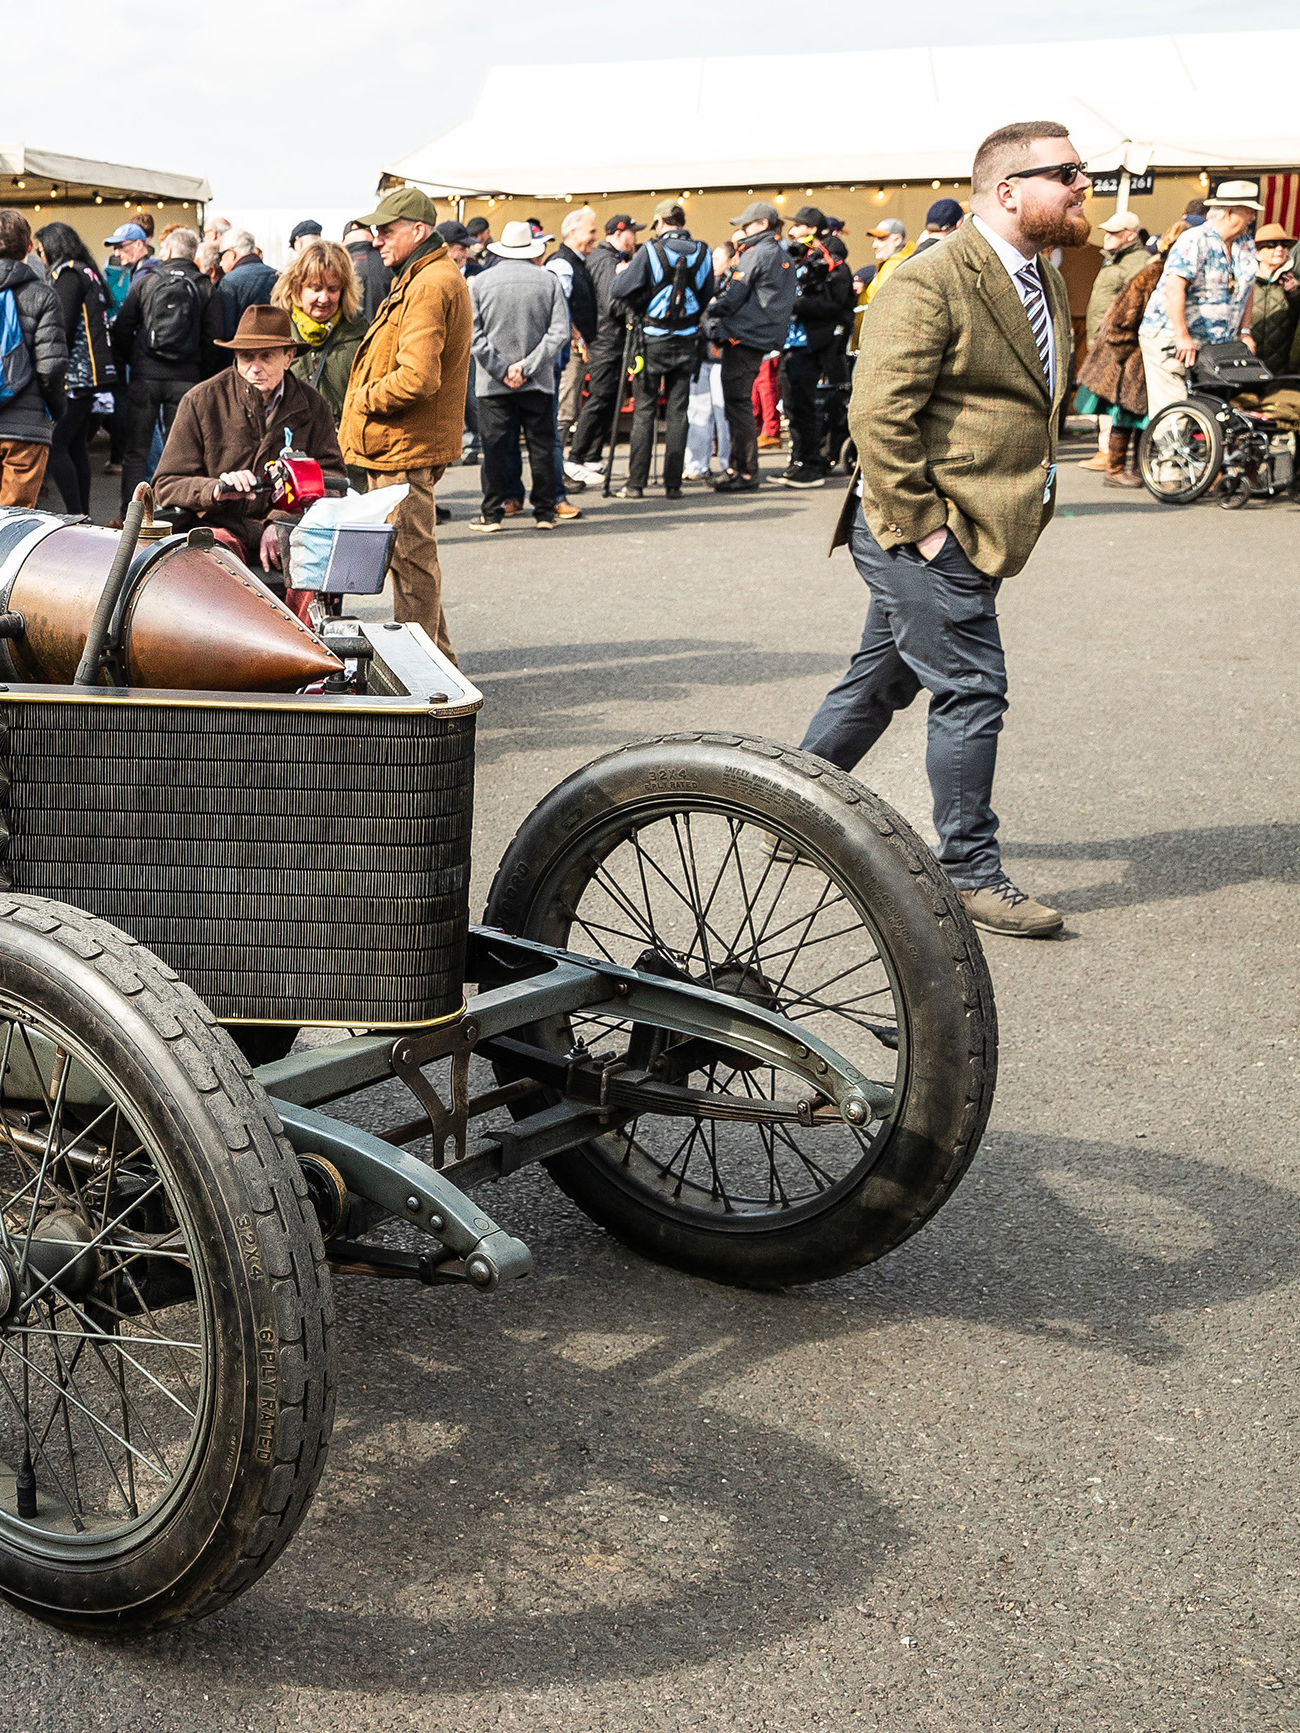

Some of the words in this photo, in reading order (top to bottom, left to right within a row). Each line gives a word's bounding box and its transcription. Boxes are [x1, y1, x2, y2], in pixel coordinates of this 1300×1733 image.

[1093, 178, 1118, 192] 262
[1130, 176, 1152, 189] 261
[648, 768, 687, 782] 32X4
[670, 780, 699, 790] RATED
[234, 1213, 266, 1280] 32X4
[259, 1328, 275, 1342] 6
[260, 1349, 277, 1391] PLY
[255, 1398, 277, 1463] RATED
